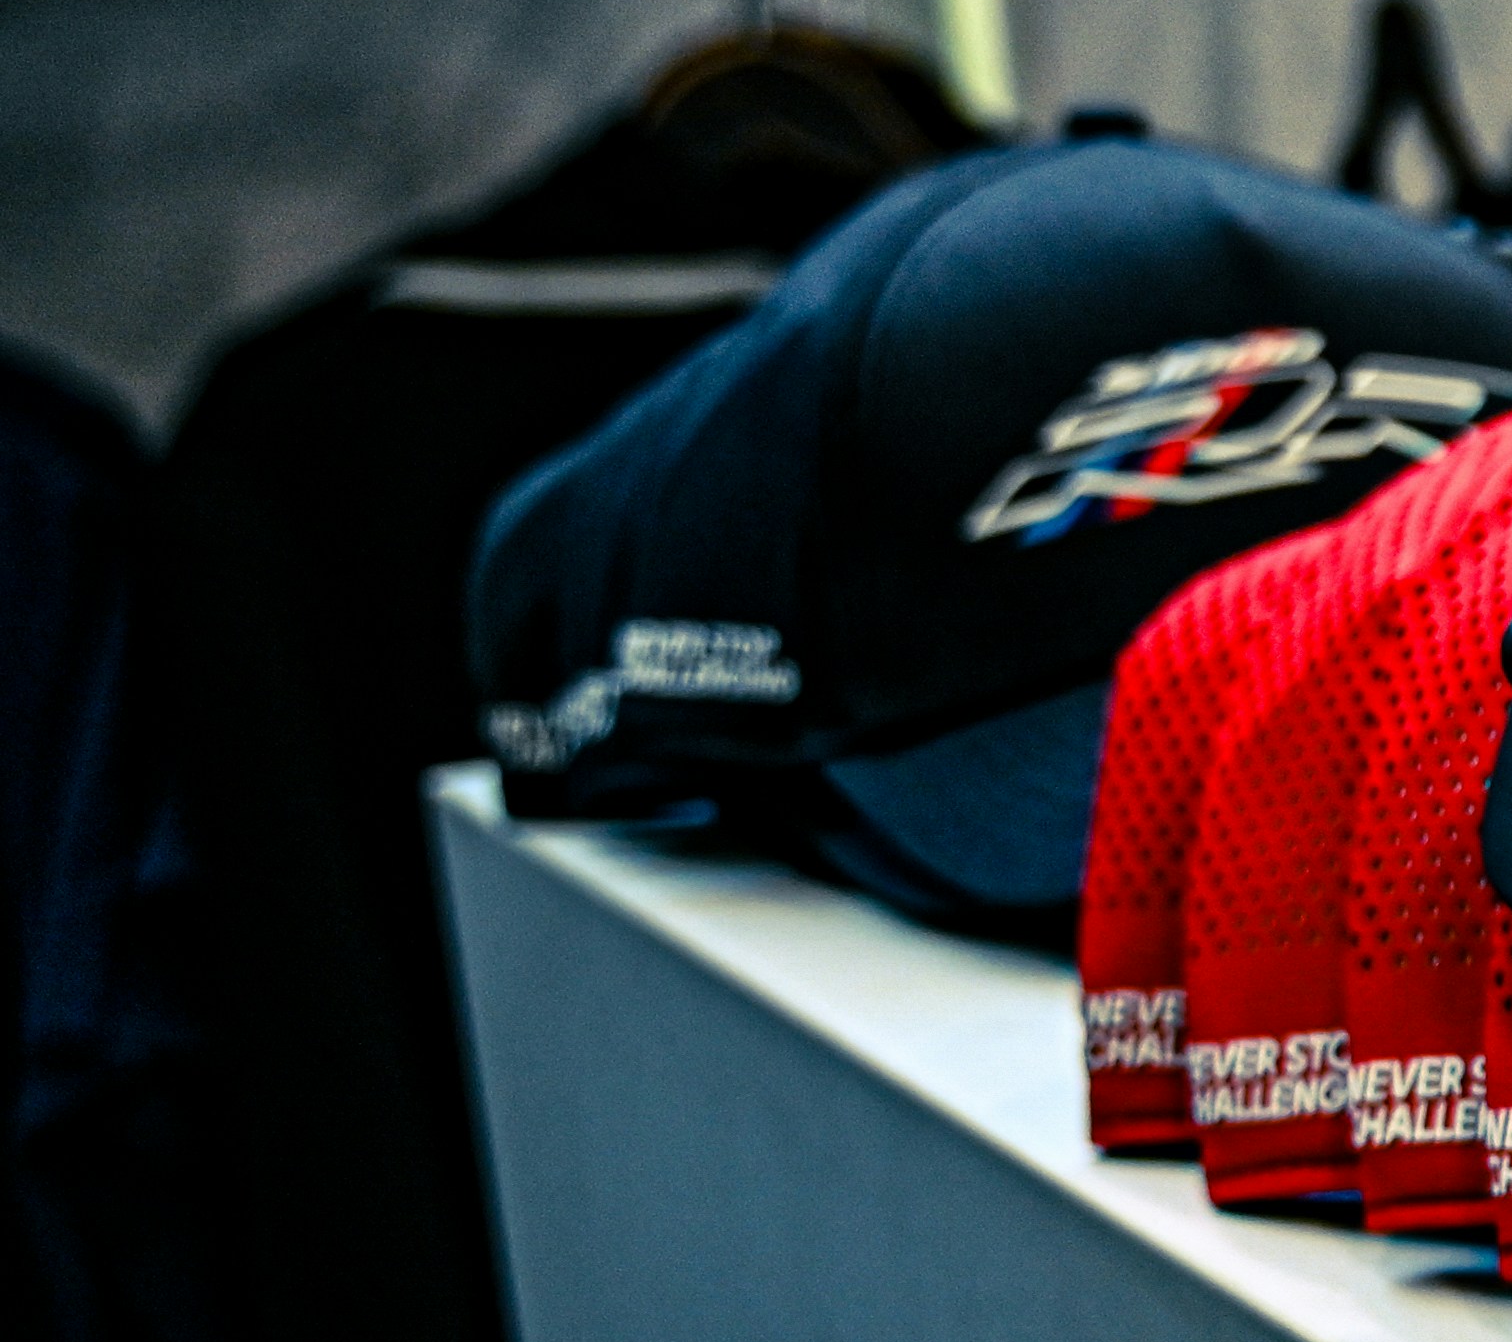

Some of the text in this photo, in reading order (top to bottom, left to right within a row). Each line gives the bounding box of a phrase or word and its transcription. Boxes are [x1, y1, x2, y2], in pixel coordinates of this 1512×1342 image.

[1085, 988, 1188, 1027] NEVE
[1085, 1032, 1188, 1070] CHAL
[1185, 1036, 1281, 1084] EVER
[1192, 1072, 1350, 1126] HALLENG
[1350, 1098, 1488, 1149] HALLE
